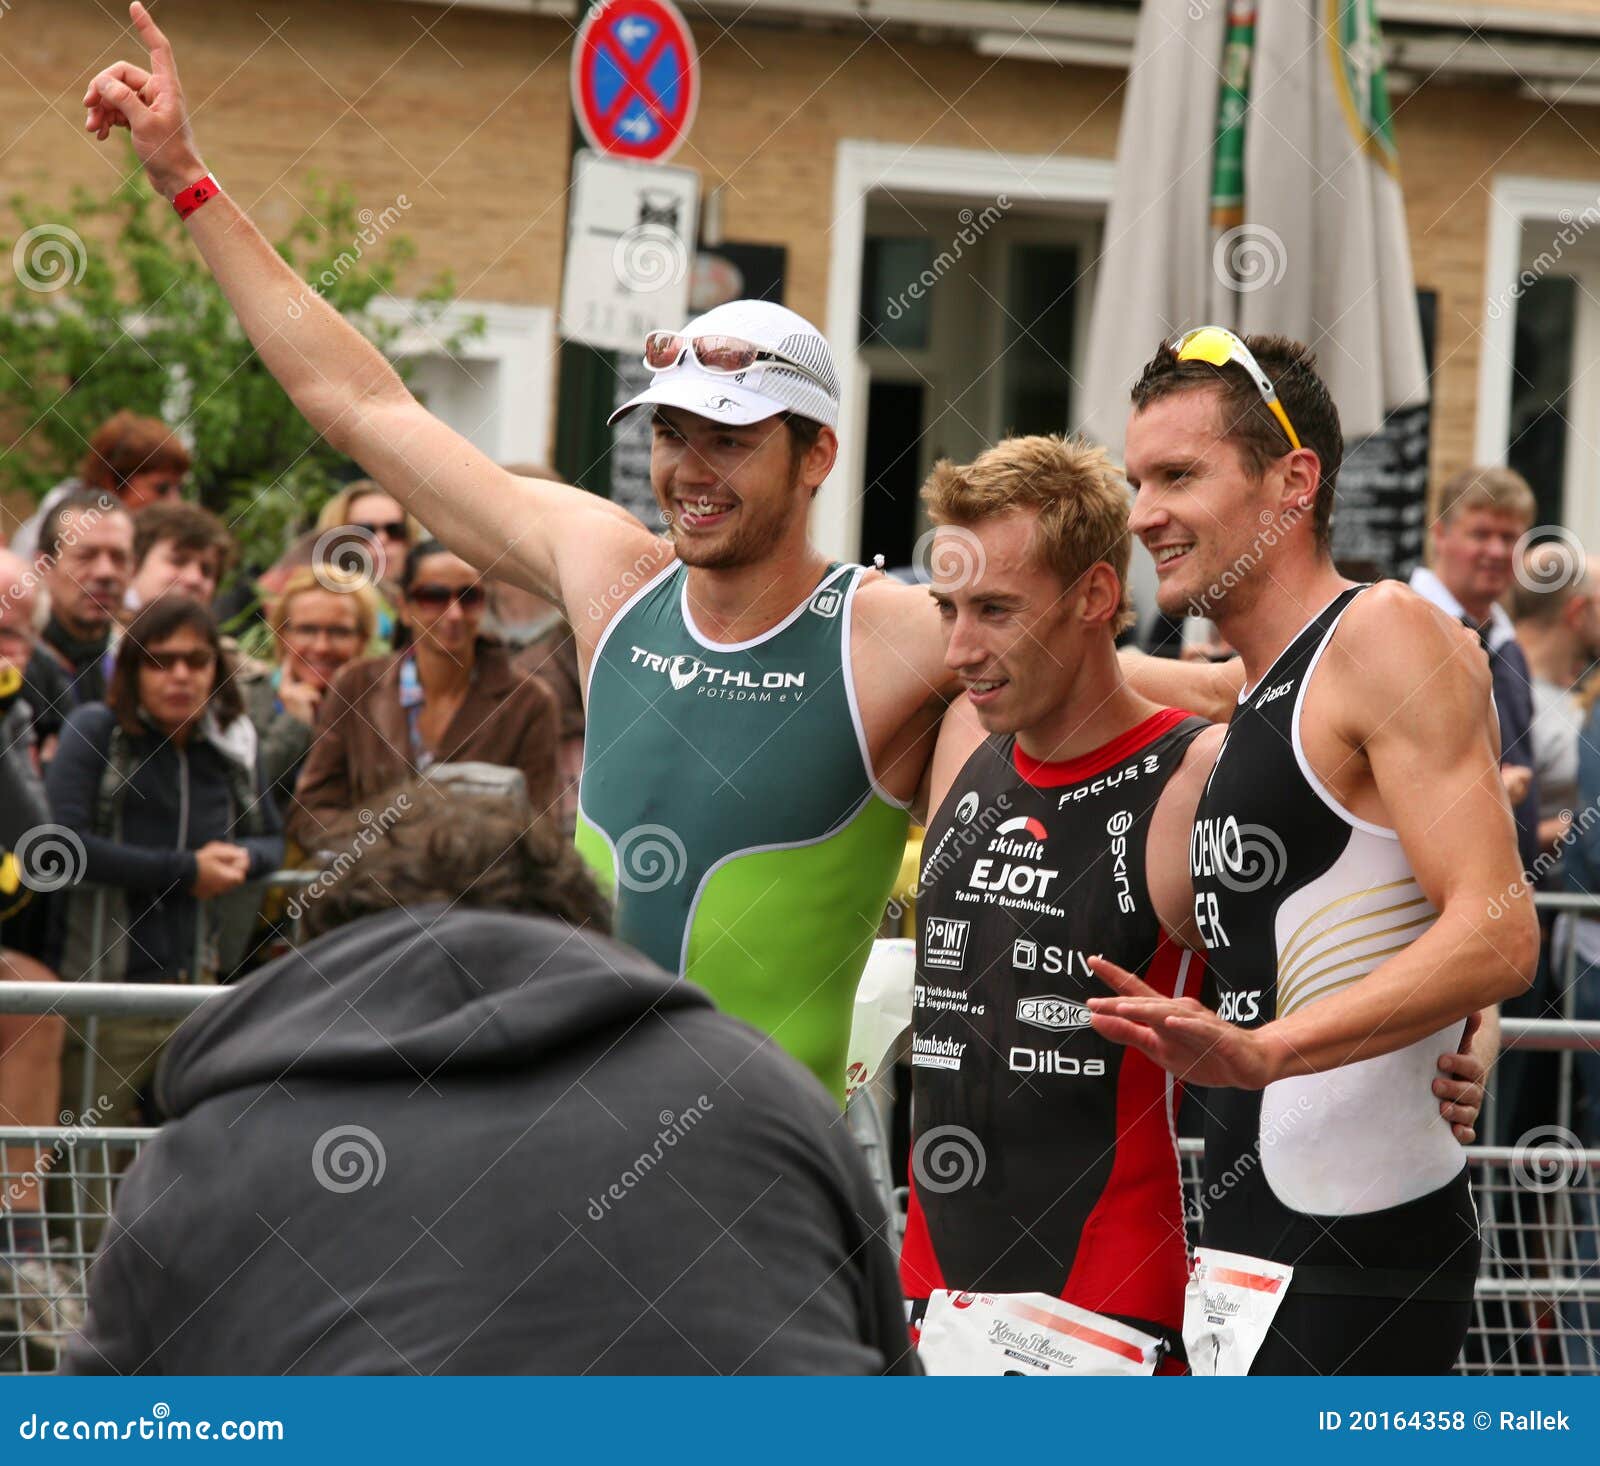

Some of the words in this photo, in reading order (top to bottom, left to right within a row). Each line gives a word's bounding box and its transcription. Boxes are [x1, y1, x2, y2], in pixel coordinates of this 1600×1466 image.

[630, 645, 806, 690] TRITHLON
[697, 686, 771, 702] POTSDAM
[1058, 764, 1138, 811] FOCUS
[988, 837, 1045, 861] skinfit
[1190, 815, 1243, 877] DENO
[968, 858, 1059, 898] EJOT
[955, 889, 980, 903] Team
[983, 892, 997, 904] TV
[999, 895, 1065, 918] Buschhütten
[1195, 892, 1231, 949] ER
[926, 986, 968, 1000] Volksbank
[926, 997, 969, 1012] Siegerland
[912, 1031, 967, 1057] Krombacher
[1008, 1047, 1105, 1076] Dilba
[987, 1319, 1028, 1350] König
[1026, 1333, 1077, 1365] Pilsener
